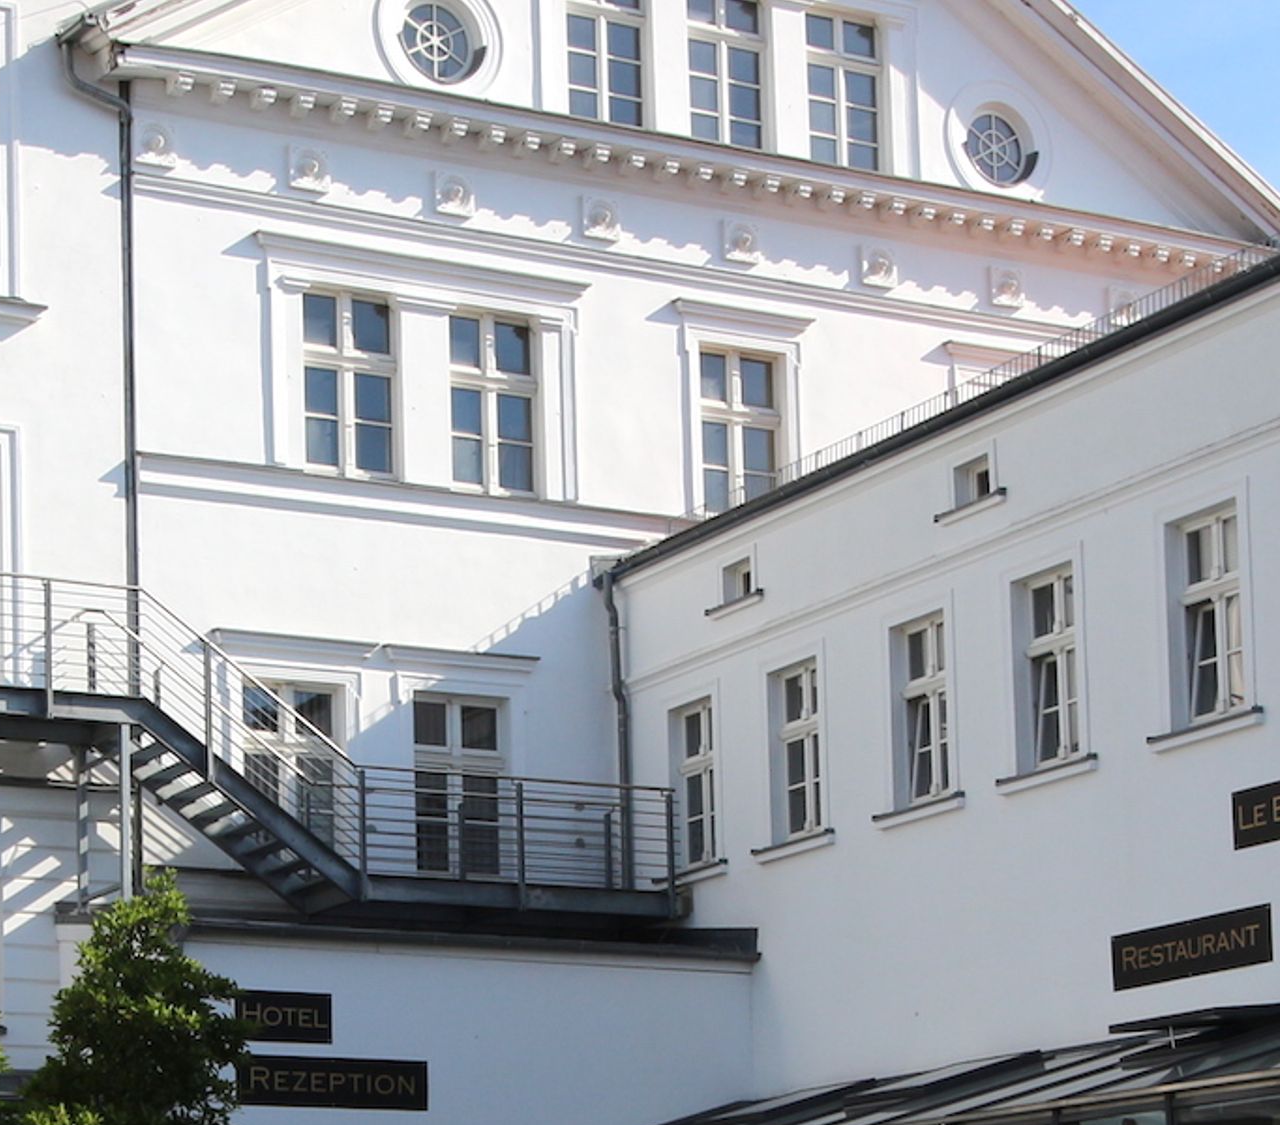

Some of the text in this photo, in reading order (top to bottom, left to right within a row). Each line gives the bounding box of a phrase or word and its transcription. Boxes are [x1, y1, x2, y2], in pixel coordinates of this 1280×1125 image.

[1238, 803, 1267, 831] LE
[1122, 924, 1260, 971] RESTAURANT
[242, 1003, 329, 1029] HOTEL
[250, 1066, 417, 1096] REZEPTION
